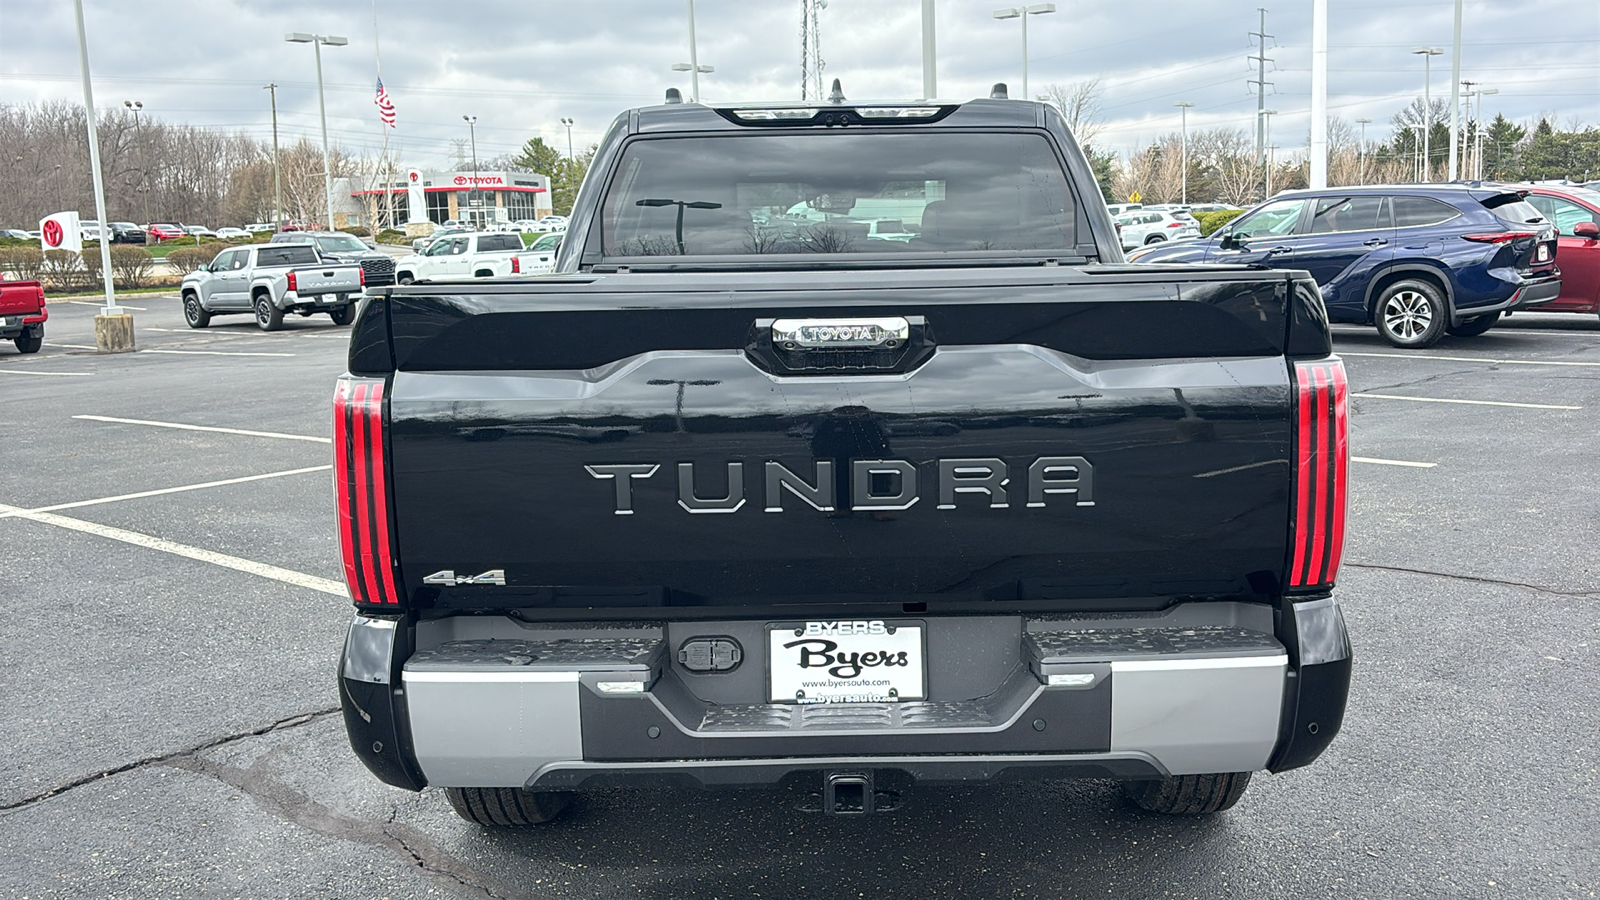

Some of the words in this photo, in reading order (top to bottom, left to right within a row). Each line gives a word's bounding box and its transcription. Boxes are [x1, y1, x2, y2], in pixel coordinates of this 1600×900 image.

[809, 326, 873, 340] TOYOTA
[584, 456, 1096, 515] TUNDRA
[805, 620, 886, 636] BYERS
[783, 638, 909, 679] Byers
[801, 678, 891, 689] www.byersauto.com
[797, 692, 899, 705] www.byersauto.com
